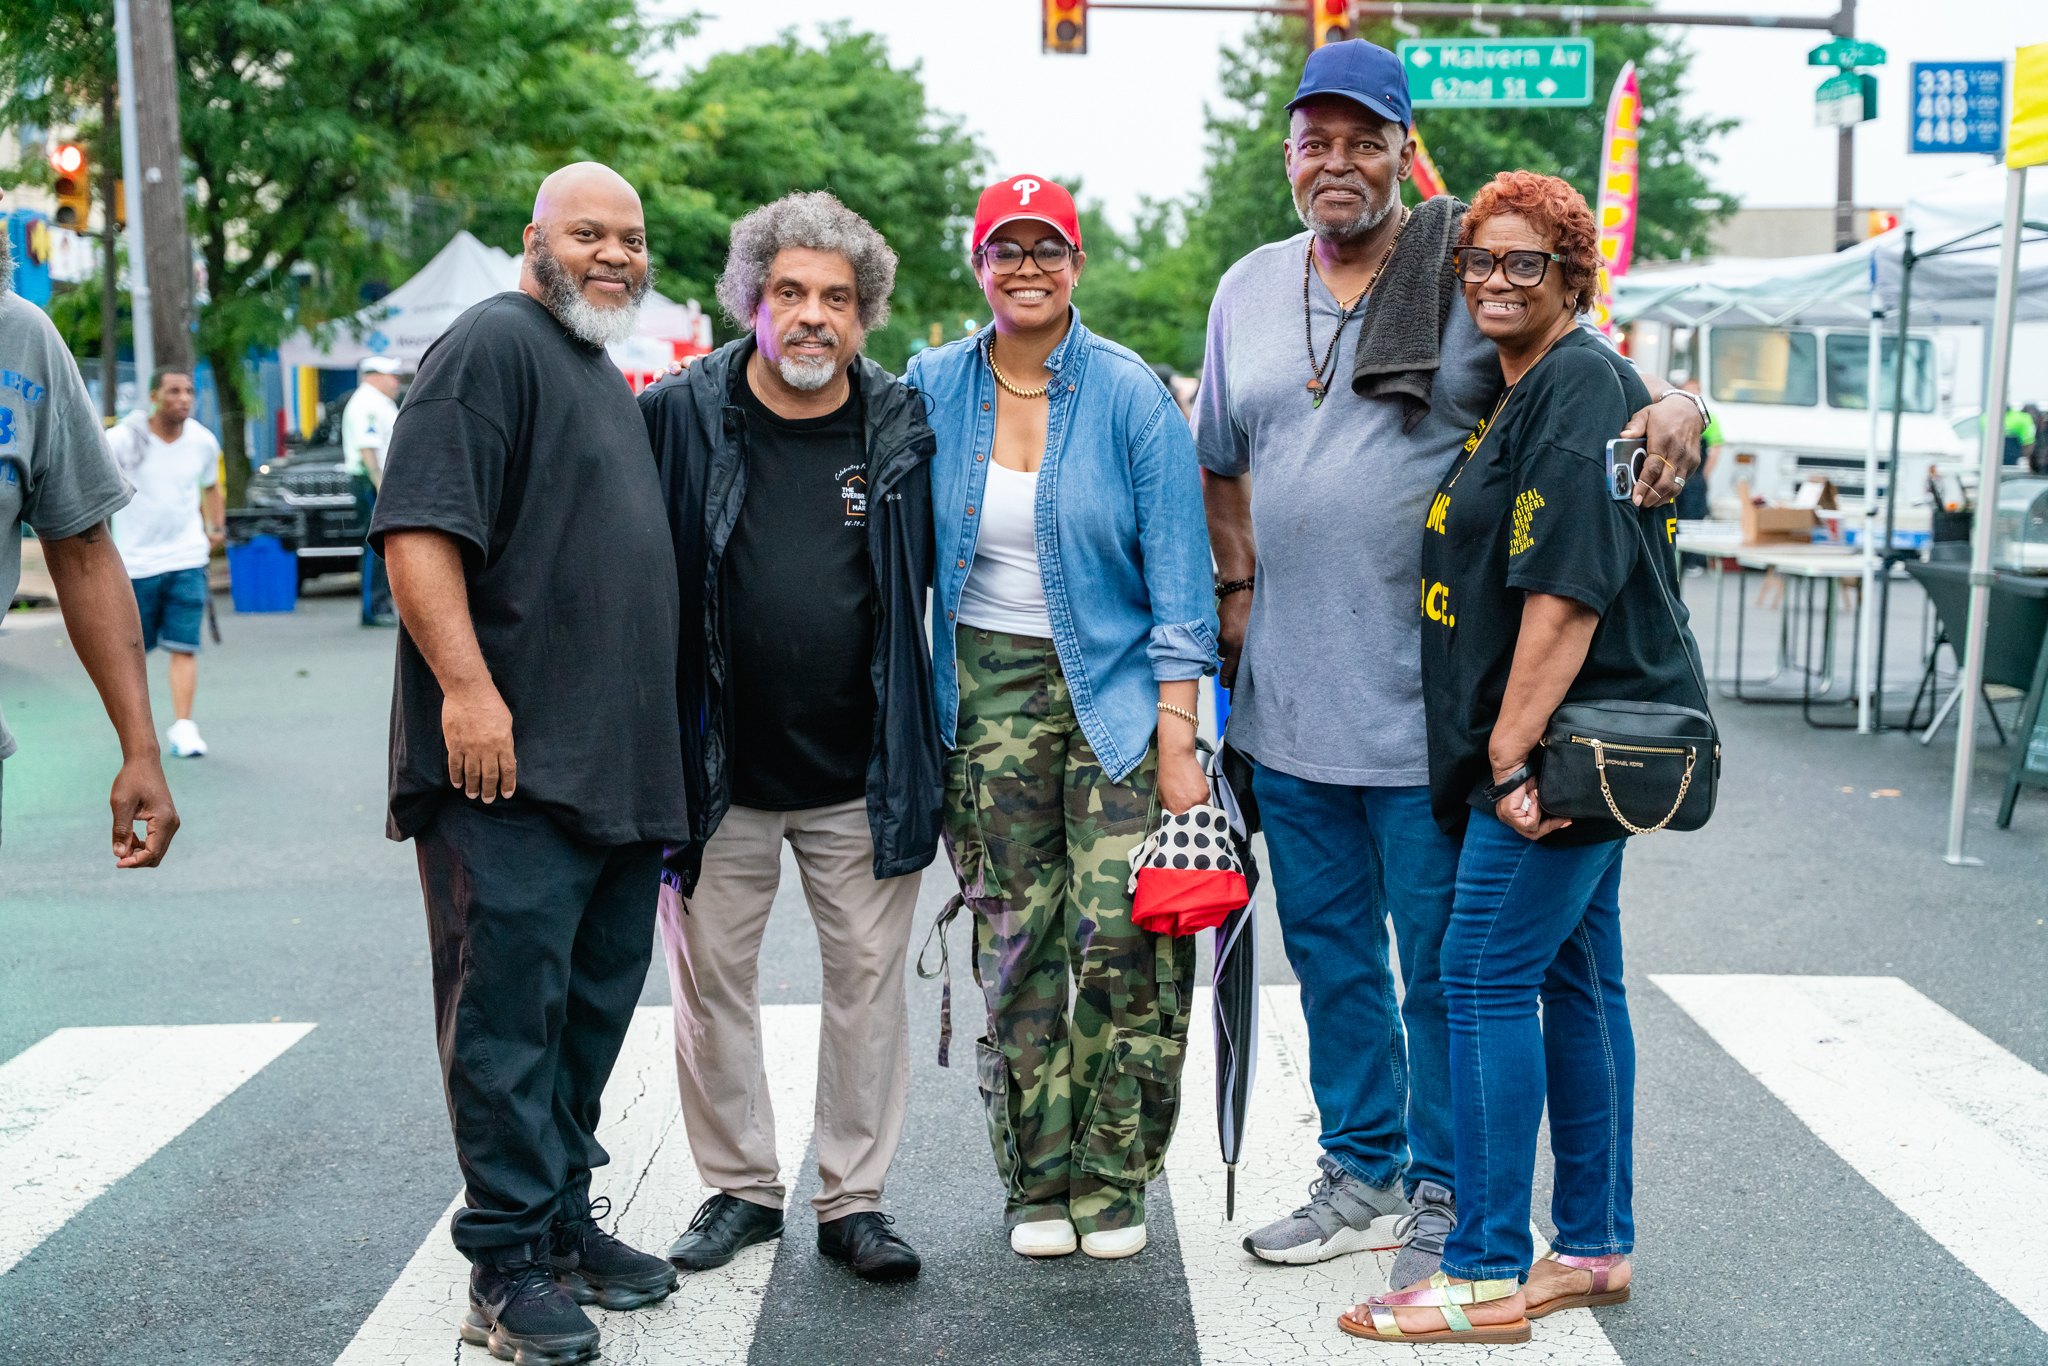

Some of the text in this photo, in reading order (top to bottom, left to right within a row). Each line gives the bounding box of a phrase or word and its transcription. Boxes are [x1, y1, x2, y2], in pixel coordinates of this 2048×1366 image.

[1440, 45, 1582, 69] Malvern Av
[1431, 77, 1527, 100] 62nd St
[1917, 69, 1968, 95] 335
[1916, 95, 1968, 119] 409
[1012, 179, 1041, 206] P
[1512, 497, 1546, 520] FATHERS
[1515, 512, 1534, 528] READ
[1510, 533, 1529, 548] THEIR
[1513, 523, 1531, 537] WITH
